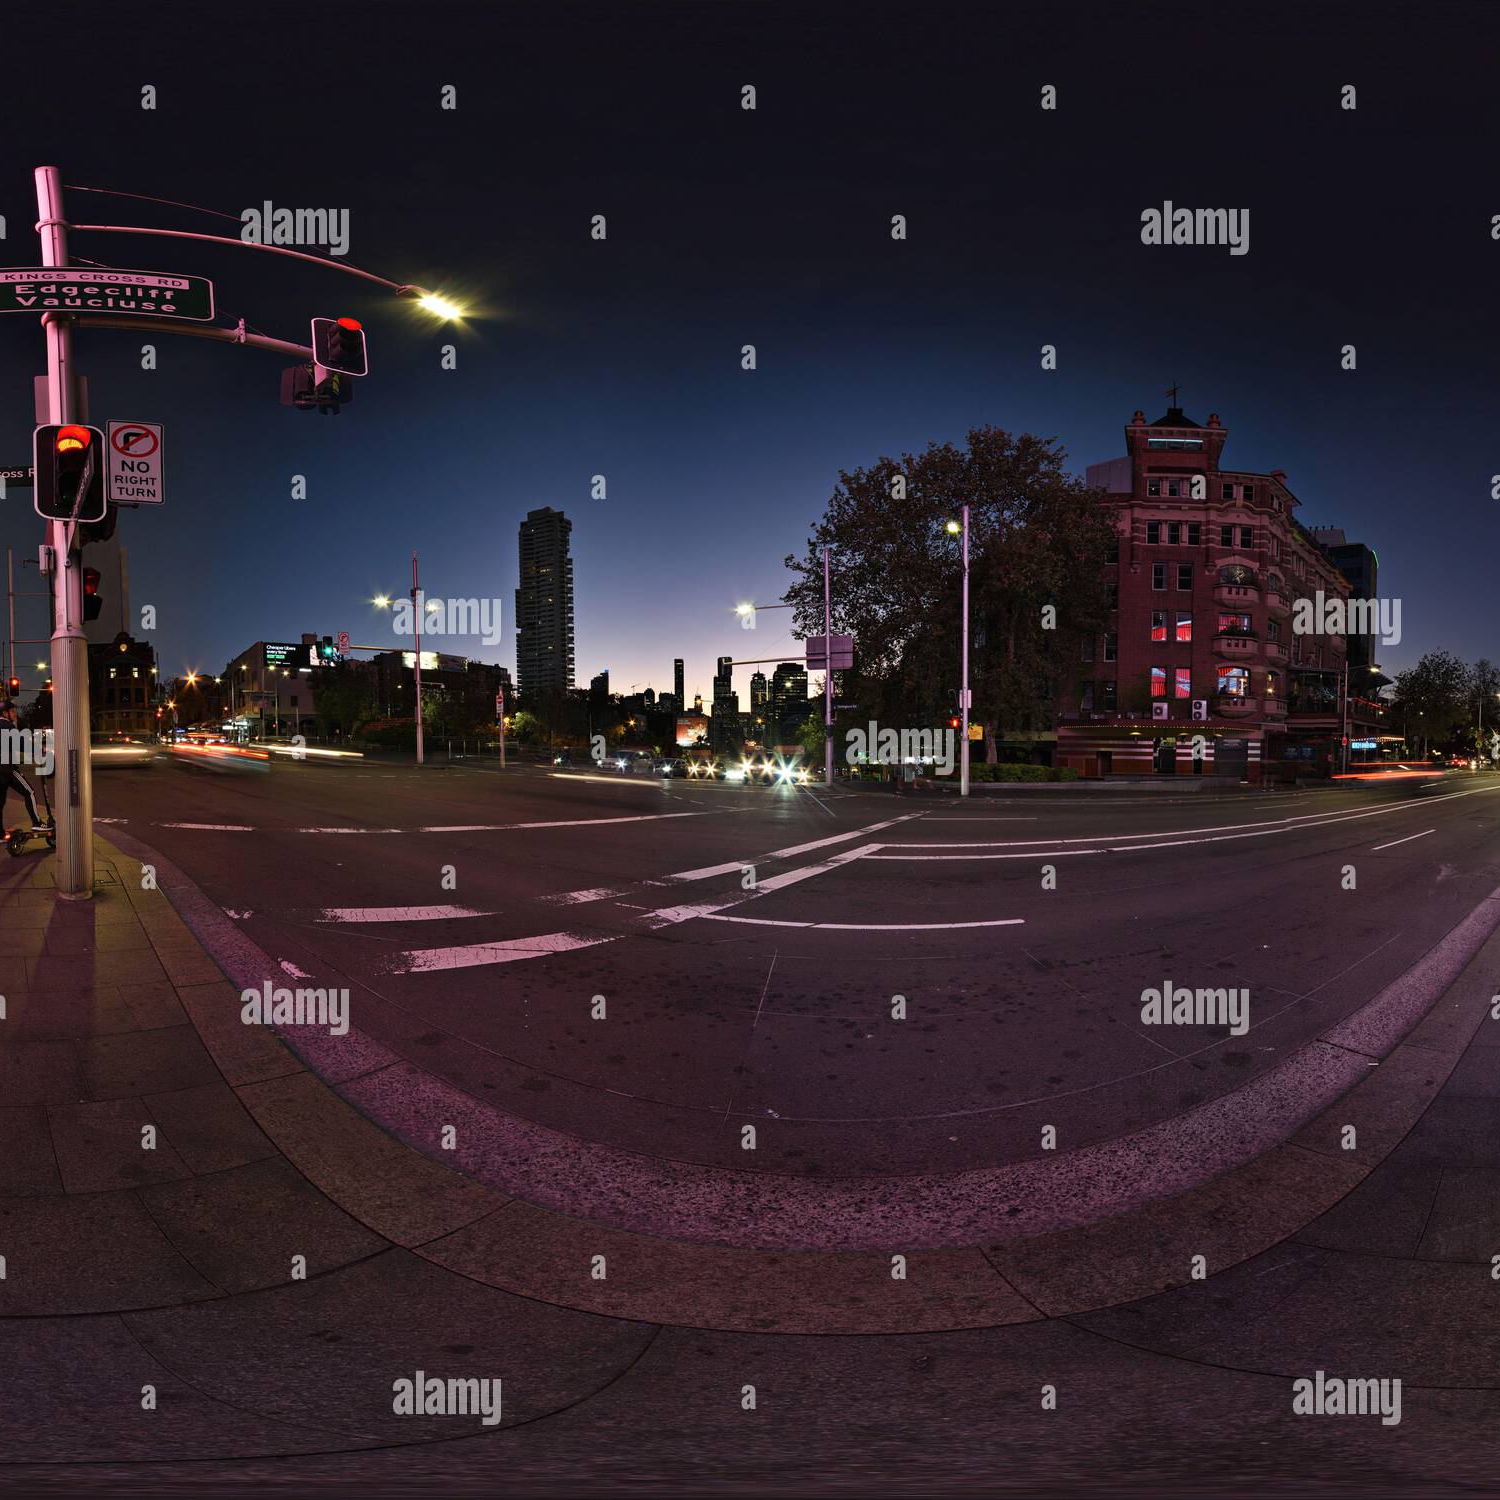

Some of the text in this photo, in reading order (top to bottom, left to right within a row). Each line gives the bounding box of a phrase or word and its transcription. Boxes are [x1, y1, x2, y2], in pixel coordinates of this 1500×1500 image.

[4, 273, 183, 287] KINGS CROSS RD
[15, 284, 174, 300] Edgecliff
[15, 296, 177, 312] Vaucluse
[121, 460, 150, 473] NO
[114, 475, 157, 486] RIGHT
[117, 486, 156, 498] TURN
